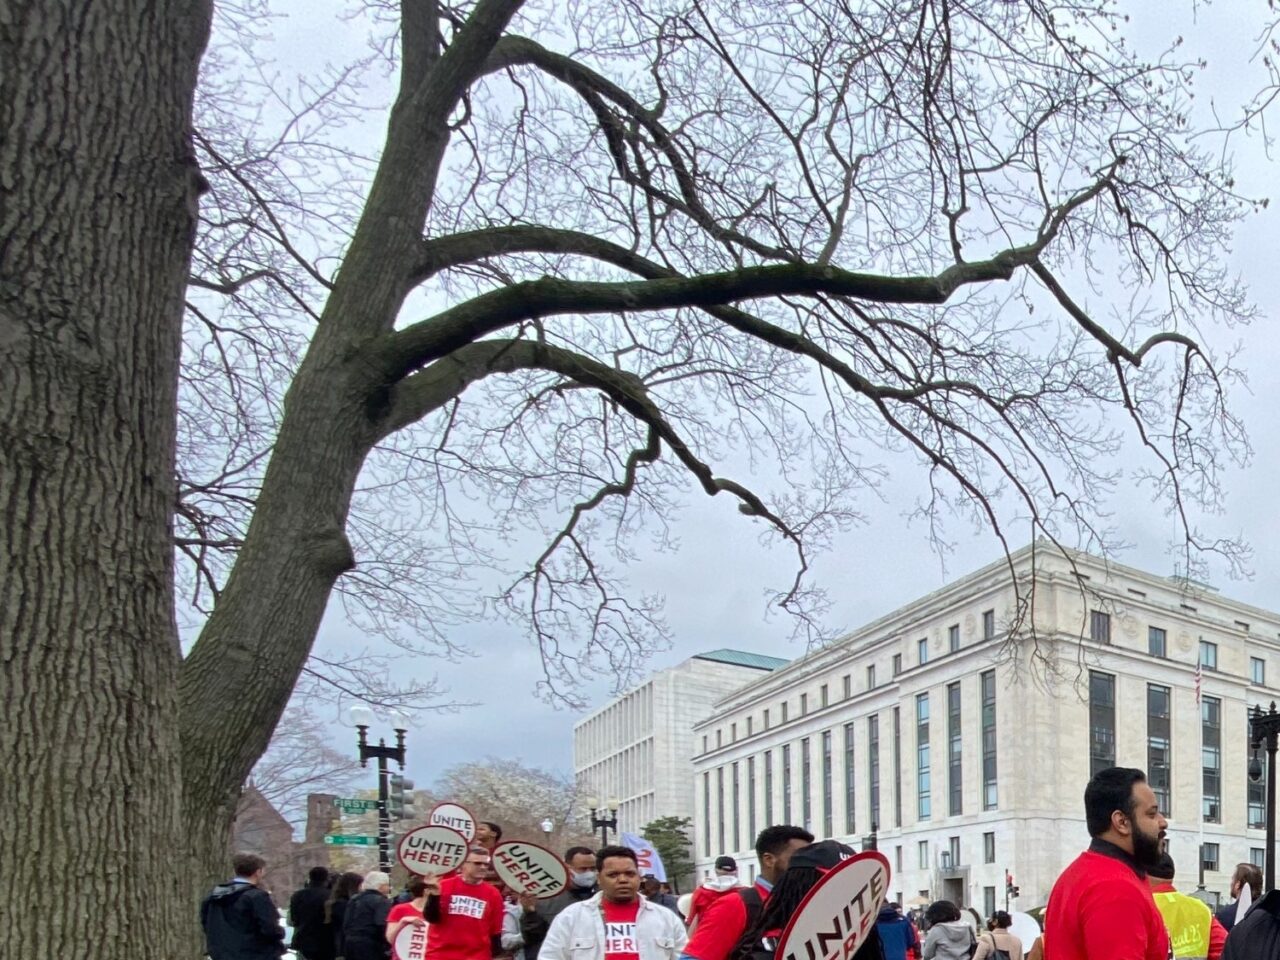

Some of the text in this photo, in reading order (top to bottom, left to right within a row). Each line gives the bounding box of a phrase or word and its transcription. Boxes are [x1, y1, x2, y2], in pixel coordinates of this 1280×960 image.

[334, 799, 366, 809] FIRST
[433, 813, 472, 830] UNITE
[408, 836, 465, 856] UNITE
[403, 848, 459, 868] HERE!
[495, 851, 549, 895] HERE!
[509, 844, 563, 892] UNITE
[449, 905, 481, 917] HERE!
[450, 896, 485, 909] UNITE
[606, 938, 639, 952] ER
